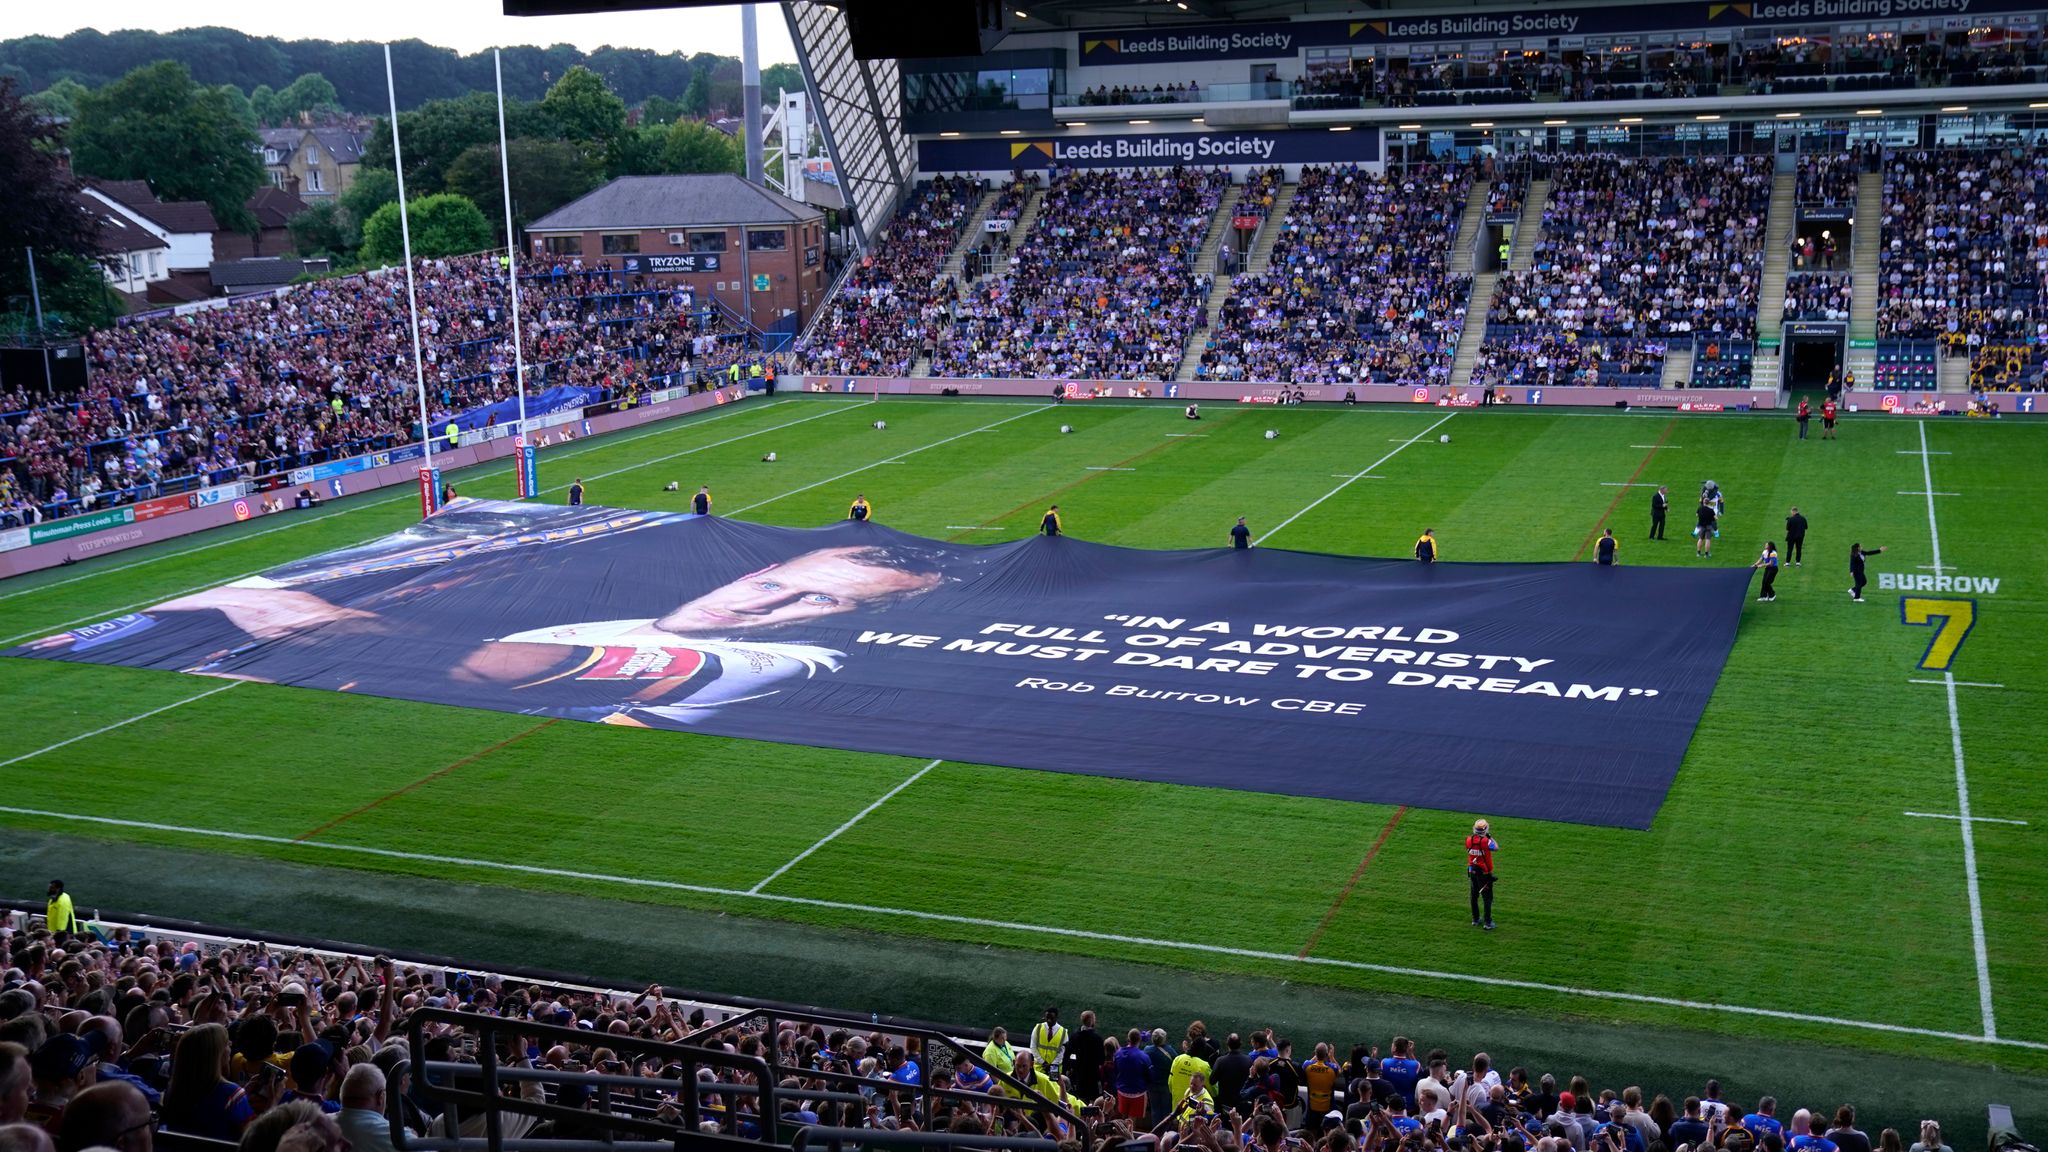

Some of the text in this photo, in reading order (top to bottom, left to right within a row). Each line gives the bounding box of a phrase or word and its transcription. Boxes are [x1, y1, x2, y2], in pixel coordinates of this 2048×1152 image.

[1753, 2, 1810, 19] Leeds
[1814, 0, 1892, 17] Building
[1388, 14, 1579, 37] Leeds Building Society
[1119, 32, 1292, 54] Leeds Building Society
[1055, 136, 1275, 161] Leeds Building Society
[649, 256, 695, 267] TRYZONE
[33, 525, 72, 540] Minuteman
[72, 520, 92, 531] Press
[91, 516, 111, 527] Leeds
[1878, 573, 2000, 594] BURROW
[1189, 621, 1232, 634] A
[1252, 623, 1460, 645] WORLD
[1900, 596, 1978, 671] 7
[856, 630, 941, 649] WE
[942, 637, 1111, 662] MUST
[1113, 651, 1280, 676] DARE
[1294, 664, 1374, 682] TO
[979, 622, 1556, 673] FULL OF ADVERISTY
[1015, 676, 1367, 716] Rob Burrow CBE
